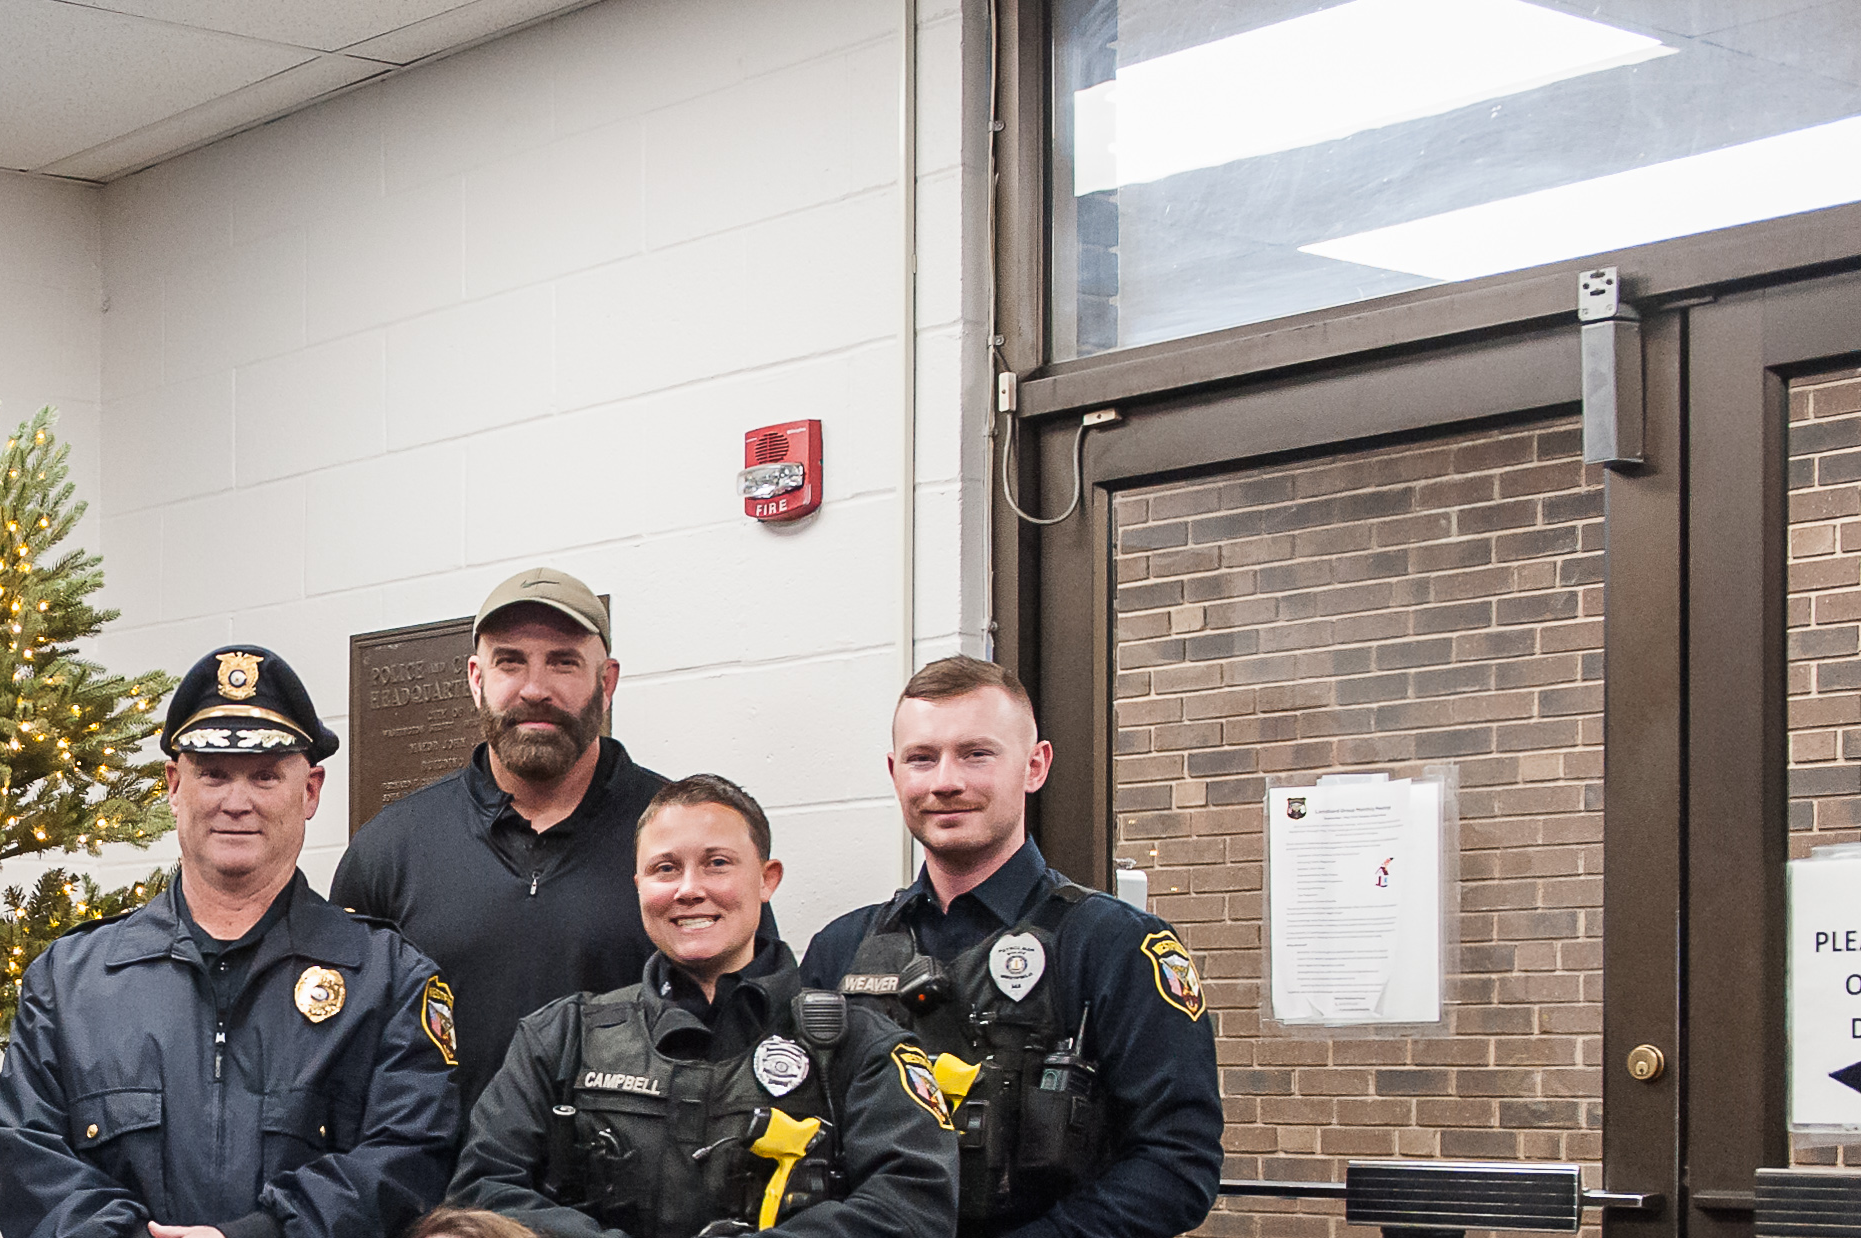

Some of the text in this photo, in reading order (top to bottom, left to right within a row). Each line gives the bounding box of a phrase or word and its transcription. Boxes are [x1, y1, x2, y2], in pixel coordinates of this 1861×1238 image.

[755, 498, 788, 517] FIRE
[1815, 930, 1861, 952] PLE
[844, 976, 899, 991] WEAVER
[584, 1071, 661, 1096] CAMPBELL
